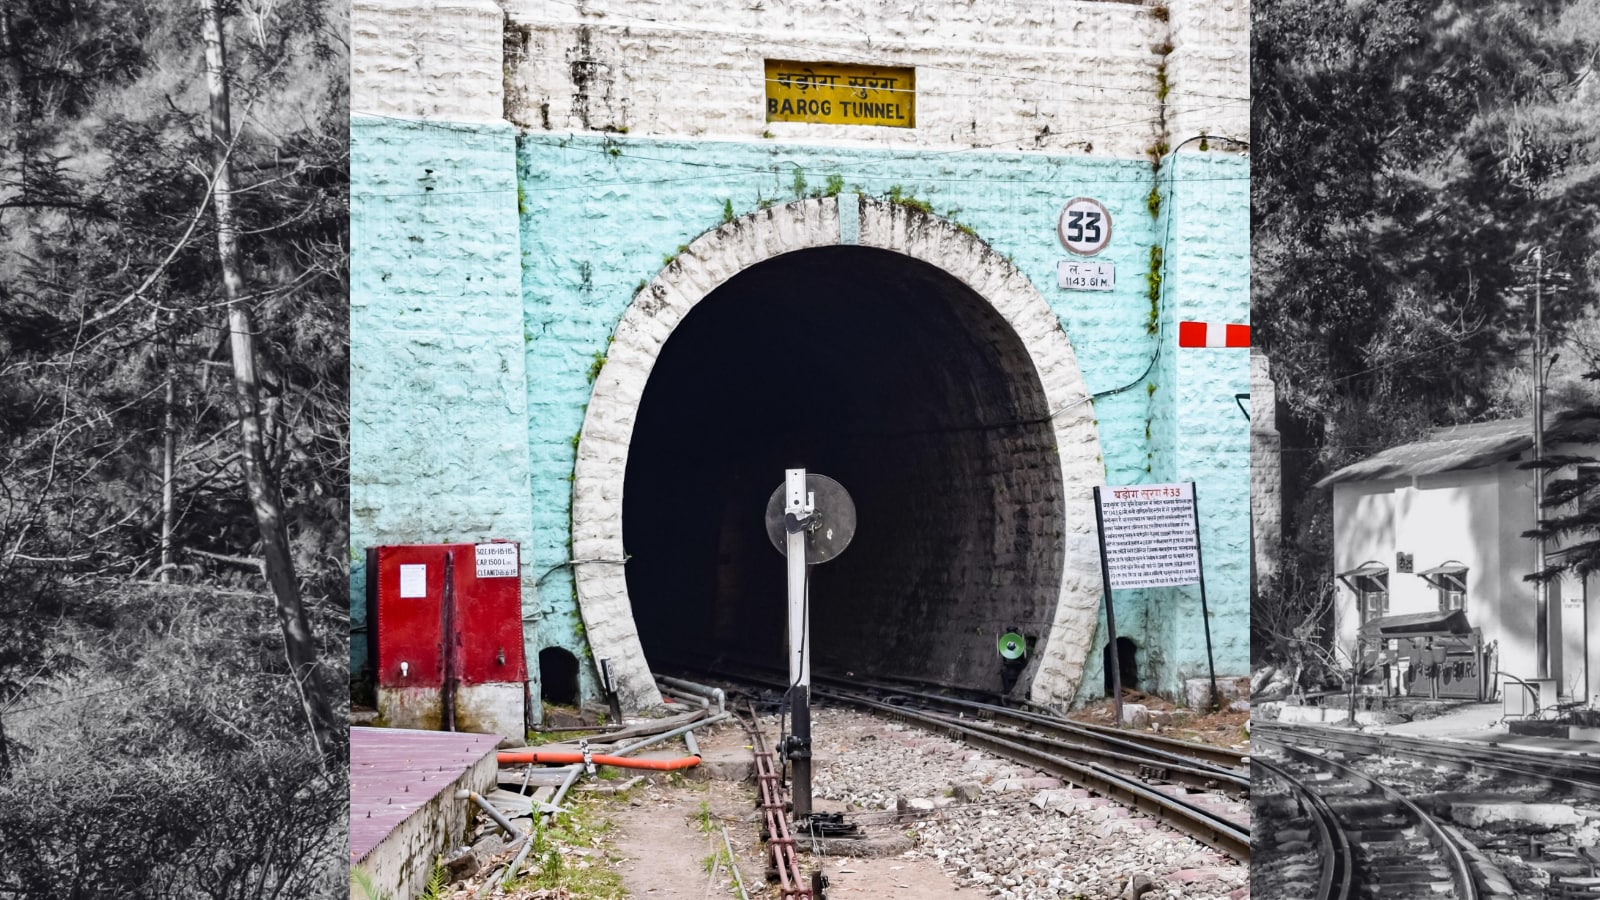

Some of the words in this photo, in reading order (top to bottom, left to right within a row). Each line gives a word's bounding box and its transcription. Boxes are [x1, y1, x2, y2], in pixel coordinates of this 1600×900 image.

[768, 98, 831, 116] BAROG
[840, 101, 905, 119] TUNNEL
[1067, 210, 1101, 243] 33
